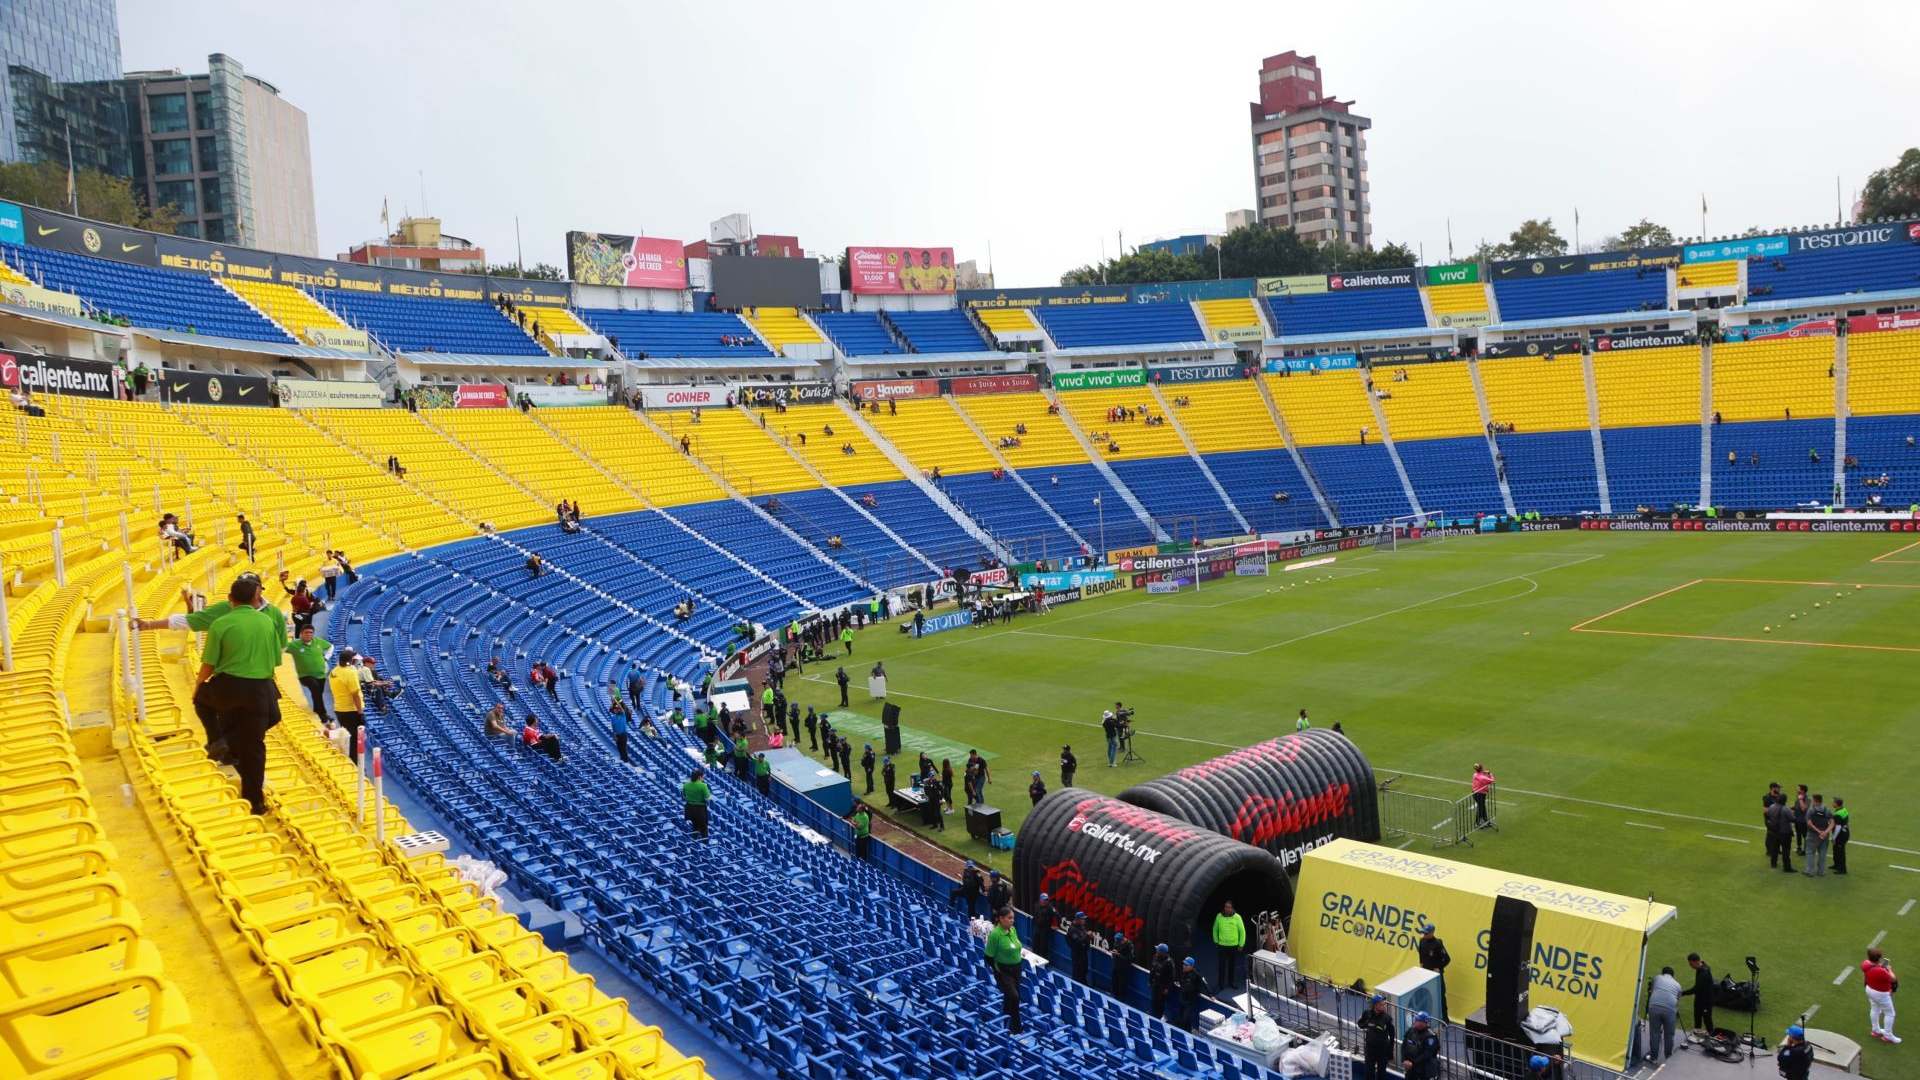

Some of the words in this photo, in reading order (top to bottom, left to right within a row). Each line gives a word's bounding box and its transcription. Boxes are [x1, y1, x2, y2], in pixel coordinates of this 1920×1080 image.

[1343, 273, 1411, 288] caliente.mx
[1611, 335, 1684, 349] caliente.mx
[1332, 357, 1352, 366] AT&T
[19, 360, 110, 393] caliente.mx
[1059, 378, 1083, 387] viva
[1088, 376, 1112, 385] viva
[1117, 374, 1141, 384] viva
[666, 391, 711, 404] GONHER
[1420, 526, 1476, 538] caliente.mx
[1521, 522, 1560, 531] Steren
[1609, 520, 1669, 531] caliente.mx
[1705, 520, 1771, 531] caliente.mx
[1812, 519, 1886, 532] caliente.mx
[1134, 554, 1208, 570] caliente.mx
[1086, 577, 1127, 596] BARDAHL
[1151, 584, 1170, 593] BBVA
[1082, 820, 1163, 864] caliente.mx
[1349, 848, 1457, 876] GRANDES
[1503, 880, 1630, 914] GRANDES
[1322, 891, 1428, 934] GRANDES
[1320, 913, 1340, 930] DE
[1476, 929, 1603, 981] GNDES
